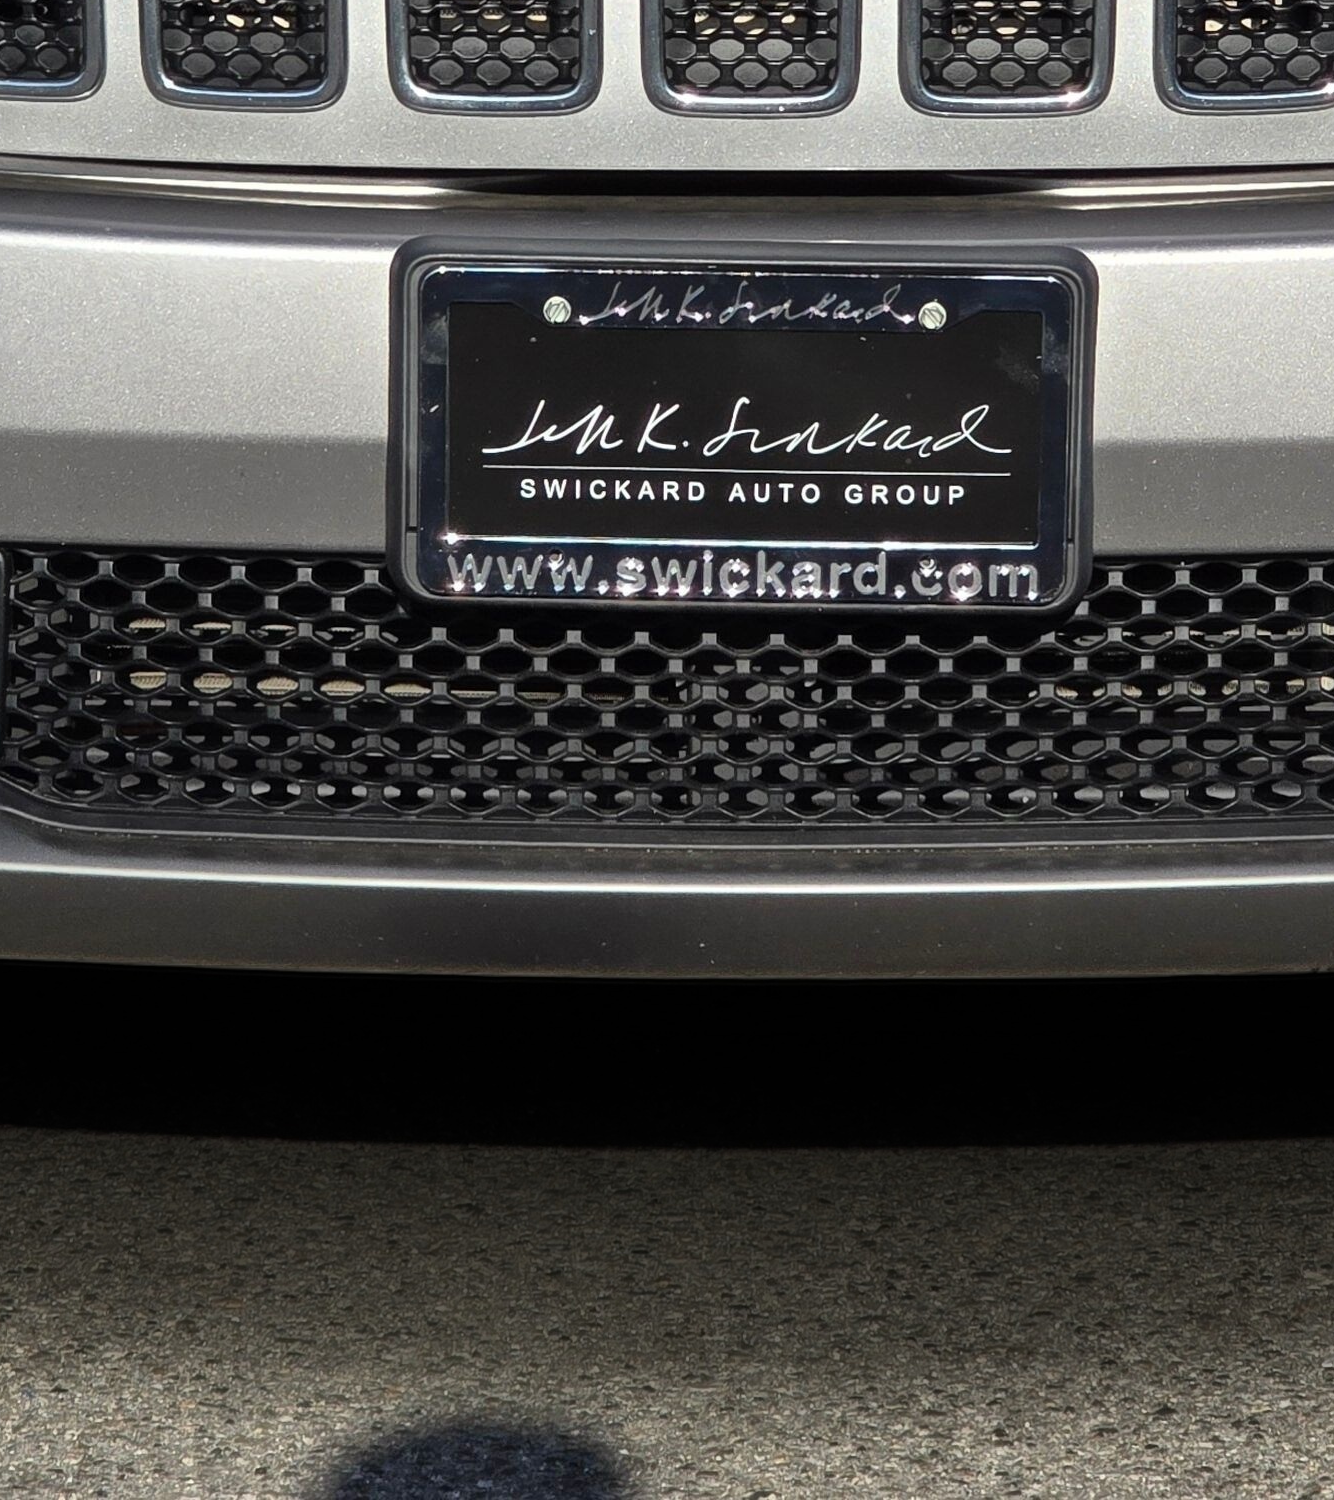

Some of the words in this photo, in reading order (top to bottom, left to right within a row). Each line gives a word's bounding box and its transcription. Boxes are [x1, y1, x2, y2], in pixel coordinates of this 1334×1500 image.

[636, 402, 690, 454] K.
[519, 477, 707, 502] SWICKARD
[728, 482, 823, 504] AUTO
[843, 484, 967, 507] GROUP
[446, 550, 1040, 600] www.swickard.com
